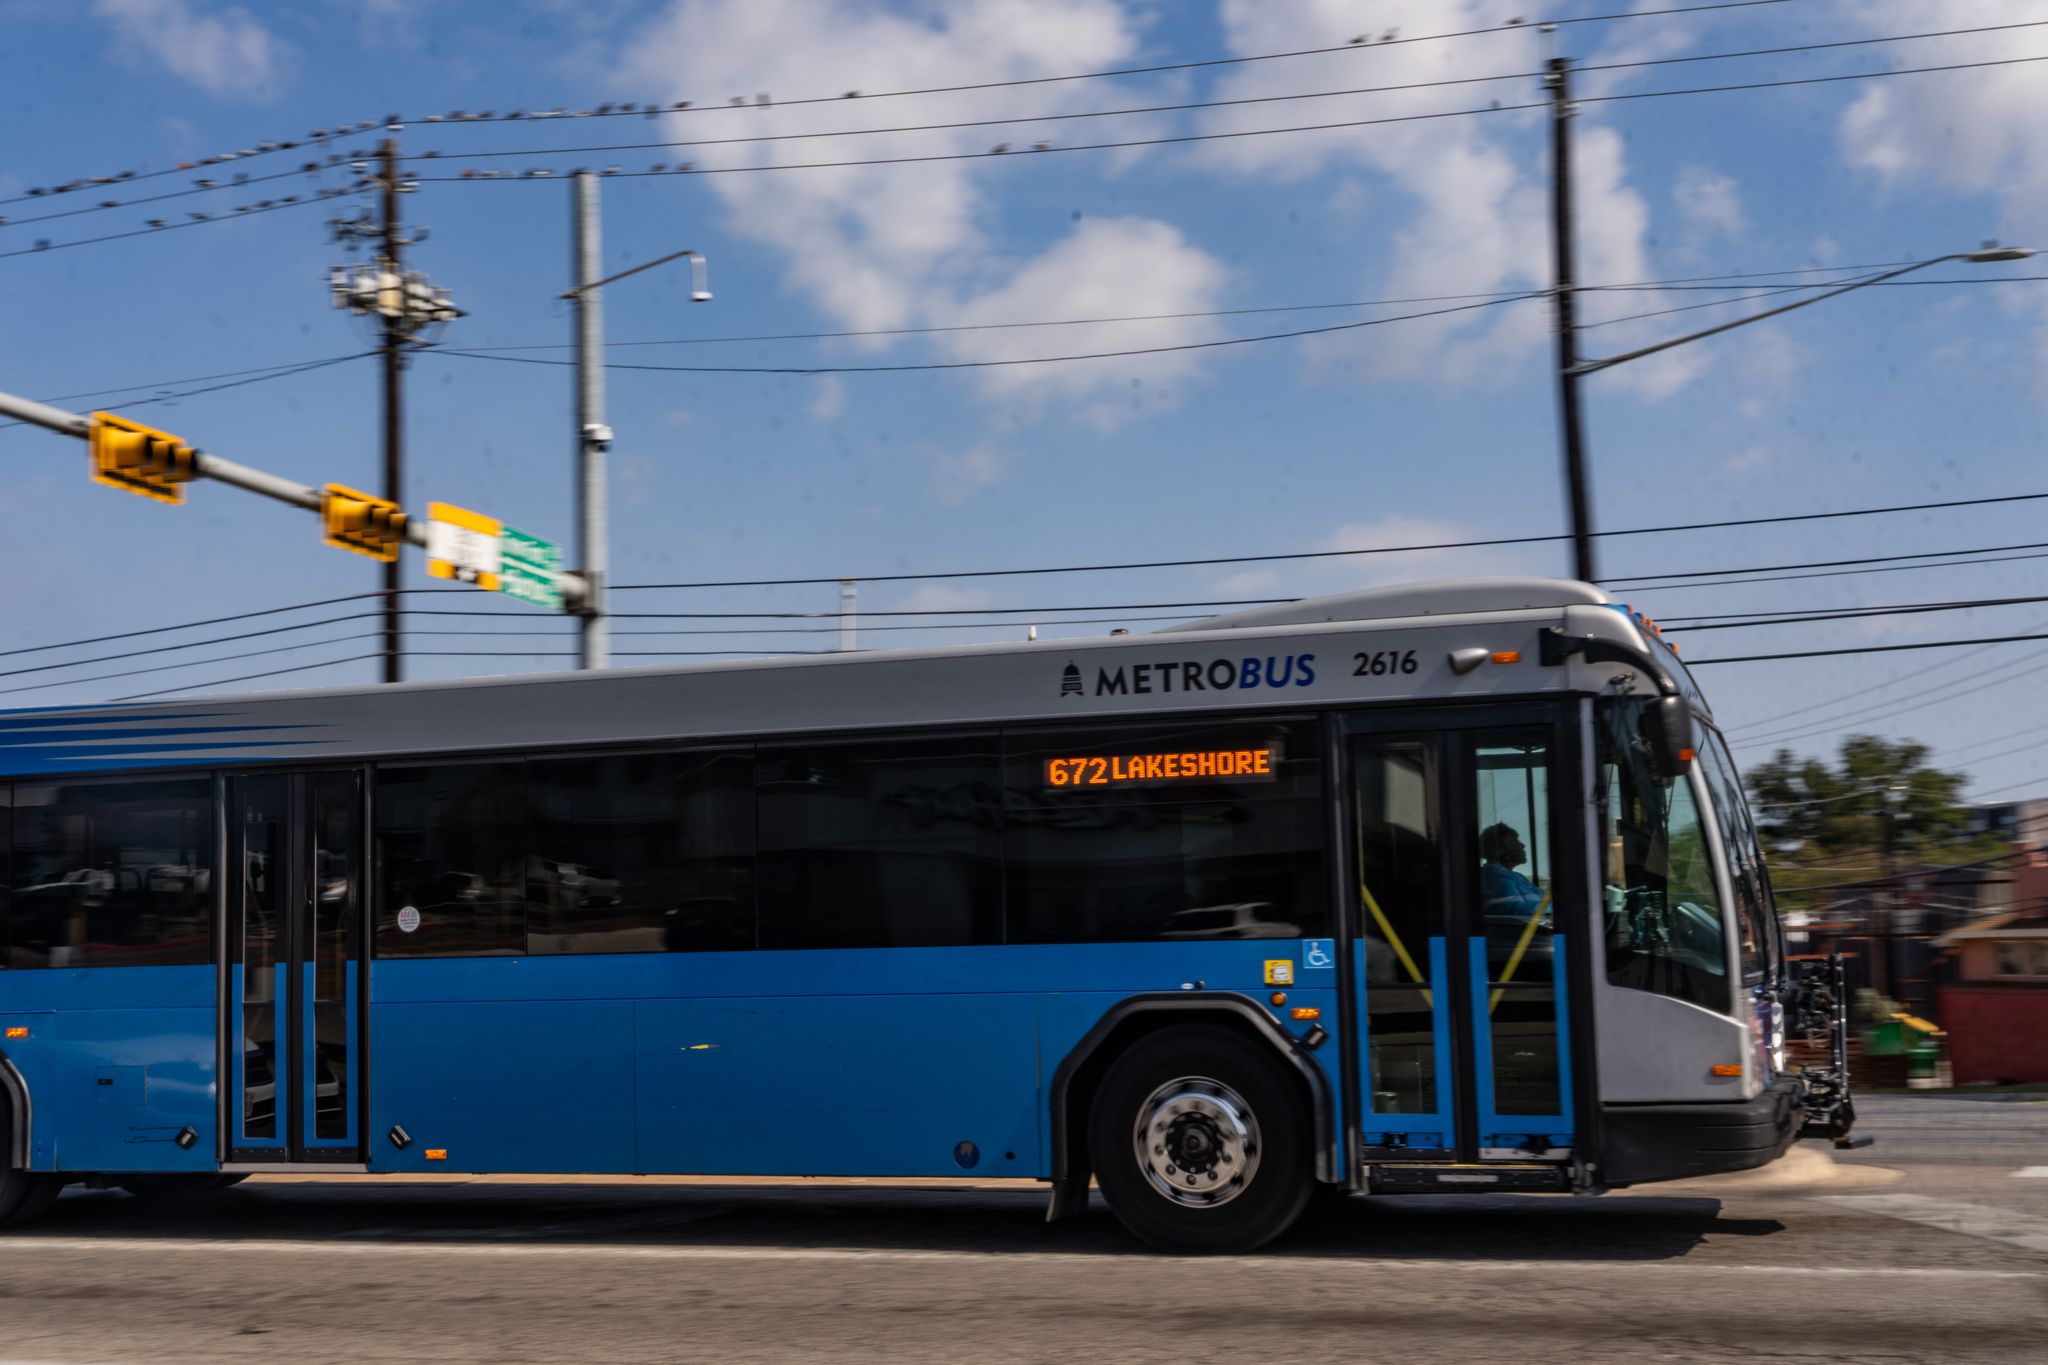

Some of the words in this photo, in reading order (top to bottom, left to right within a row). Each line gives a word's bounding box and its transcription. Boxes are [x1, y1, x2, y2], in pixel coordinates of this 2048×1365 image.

[1095, 653, 1315, 696] METROBUS
[1353, 650, 1418, 676] 2616
[1049, 757, 1108, 785] 672
[1112, 750, 1270, 779] LAKESHORE
